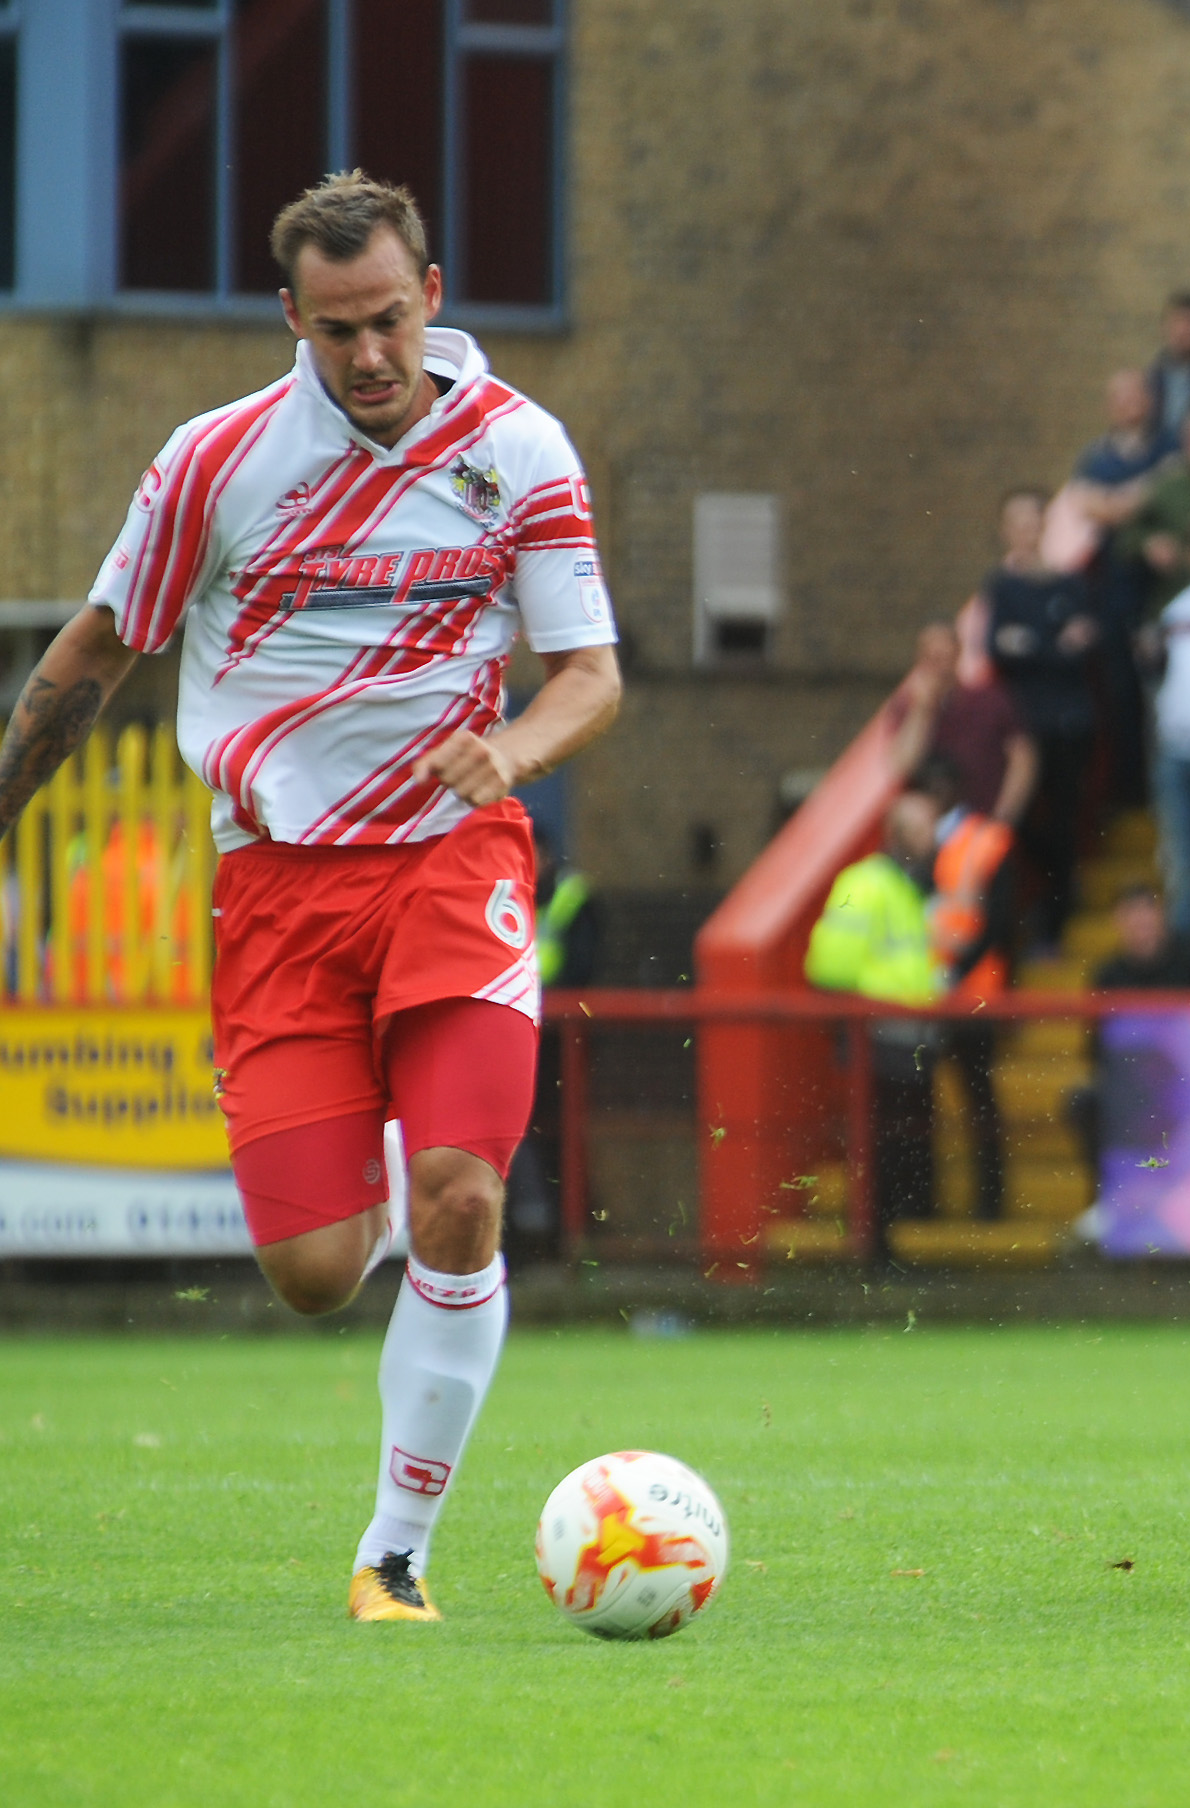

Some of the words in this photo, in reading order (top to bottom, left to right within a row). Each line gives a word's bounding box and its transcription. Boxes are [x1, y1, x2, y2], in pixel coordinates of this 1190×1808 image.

[292, 553, 402, 610] TYRE
[390, 546, 504, 604] PROS
[485, 879, 526, 949] 6
